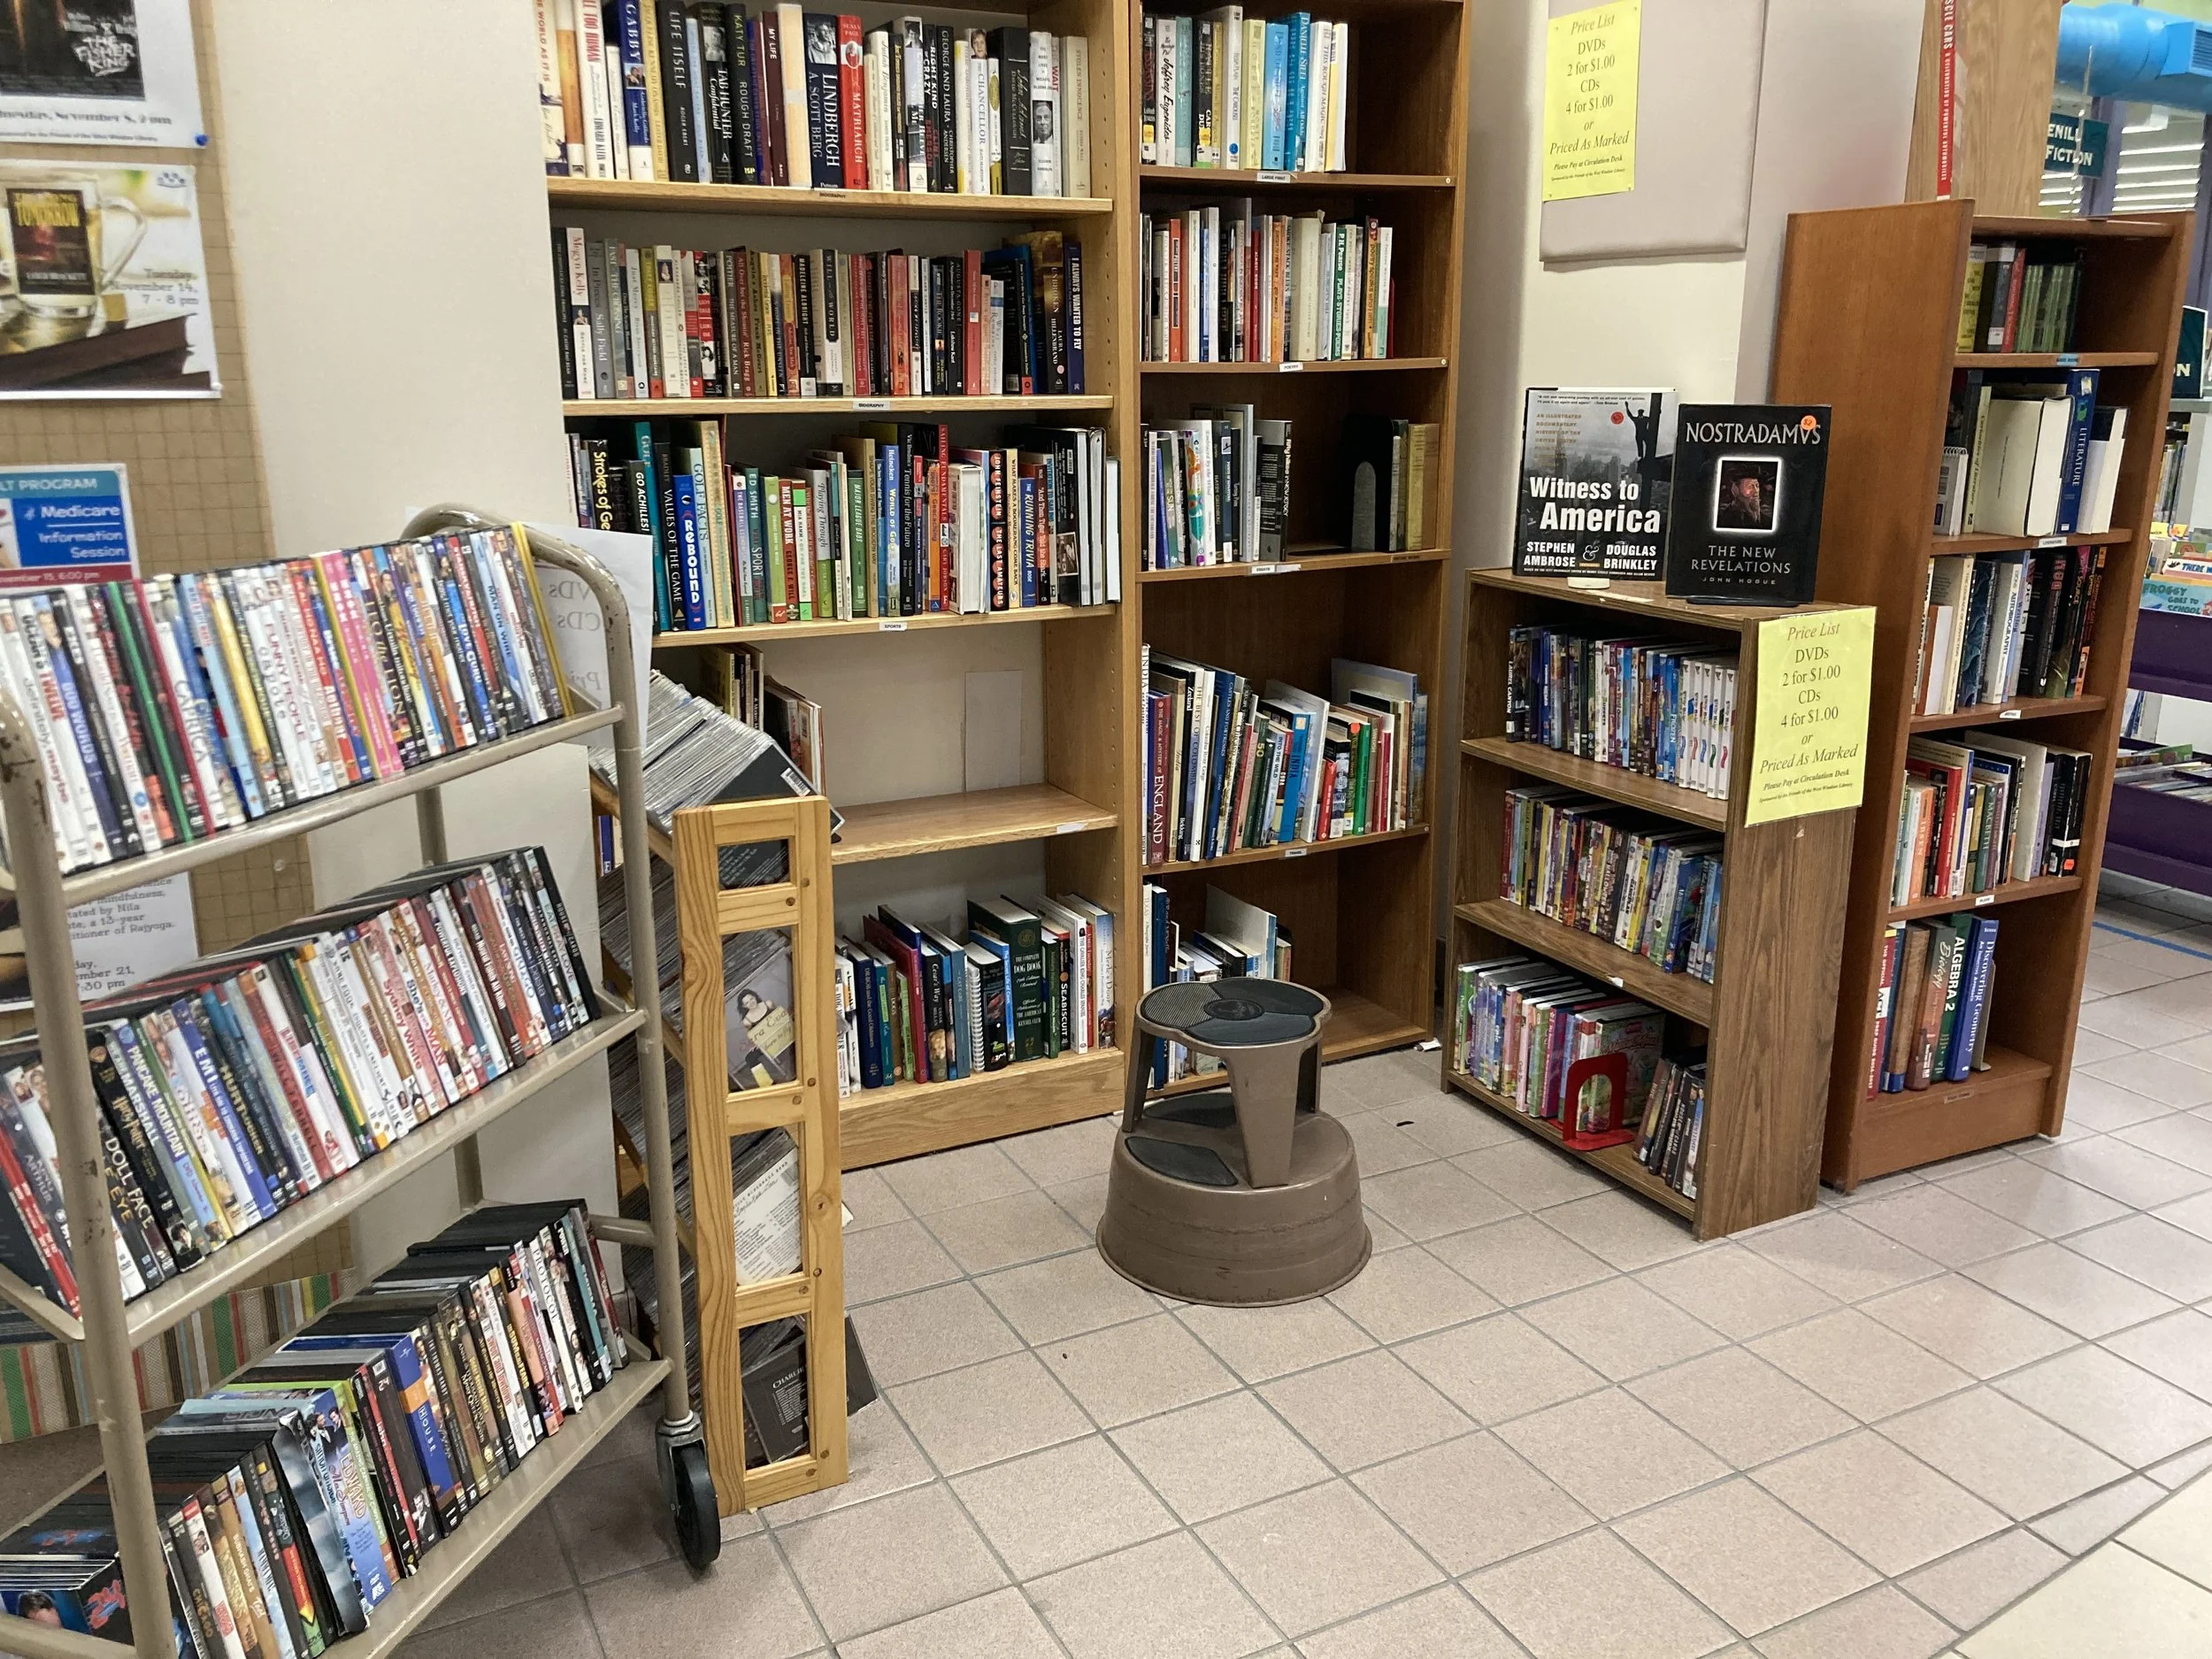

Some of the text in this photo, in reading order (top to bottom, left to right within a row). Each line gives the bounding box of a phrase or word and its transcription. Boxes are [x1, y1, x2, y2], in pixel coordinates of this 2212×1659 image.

[625, 4, 642, 61] GABBY
[768, 28, 776, 41] MY
[1571, 13, 1615, 35] Price List
[669, 11, 686, 88] LIFE ITSELF
[941, 31, 950, 68] GEORGE
[1578, 38, 1606, 55] DVDs
[718, 68, 728, 86] TAB
[1567, 54, 1616, 77] 2 for $1.00
[733, 14, 753, 157] KATY TUR ROUGH DRAFT
[1580, 79, 1600, 93] CDs
[710, 78, 722, 130] Confidential
[978, 74, 987, 144] CHANCELLOR
[1566, 94, 1614, 114] 4 for $1.00
[809, 87, 823, 157] SCOTT BERG
[822, 73, 840, 166] LINDBERGH
[852, 92, 863, 164] MATRIARCH
[1584, 120, 1594, 131] or
[1550, 131, 1630, 155] Priced As Marked
[1554, 159, 1570, 171] Please
[1584, 157, 1609, 167] Circulation
[1610, 154, 1623, 163] Desk
[572, 236, 587, 296] Megyn Kelly
[1071, 262, 1080, 292] ALWAYS
[142, 295, 198, 306] 7 8 pm
[1072, 295, 1081, 325] WANTED
[595, 313, 607, 362] Sally Field
[1073, 326, 1081, 337] TO
[1686, 422, 1821, 445] NOSTRADAMVS
[2072, 427, 2088, 487] LITERATURE
[19, 479, 97, 490] PROGRAM
[594, 451, 609, 510] Strokes of
[694, 463, 703, 500] GOLF
[903, 469, 912, 495] Tennis
[1529, 476, 1639, 501] Witness to
[749, 473, 759, 518] ED SMITH
[995, 480, 1003, 518] FEINSTEIN
[41, 505, 120, 518] Medicare
[781, 486, 794, 545] MEN AT WORK
[1024, 494, 1034, 536] RUNNING
[1540, 502, 1661, 534] America
[39, 531, 123, 543] Information
[664, 488, 683, 603] VALUES OF THE GAME
[71, 546, 125, 558] Session
[752, 547, 764, 577] SPORT
[1025, 538, 1035, 569] TRIVIA
[1524, 555, 1657, 571] AMBROSE BRINKLEY
[1526, 541, 1656, 561] STEPHEN & DOUGLAS
[1708, 545, 1777, 558] THE NEW
[1691, 559, 1791, 574] REVELATIONS
[2182, 563, 2205, 572] THERE
[2142, 583, 2187, 595] FROGGY
[2167, 605, 2200, 614] SCHOOL
[1787, 621, 1840, 641] Price List
[2001, 590, 2017, 656] AUTOBIOGRAPHY
[1794, 647, 1829, 664] DVDs
[1782, 664, 1841, 687] 2 for $1.00
[1798, 688, 1821, 704] CDs
[1781, 706, 1839, 728] 4 for $1.00
[1256, 742, 1265, 758] 50
[1801, 733, 1814, 745] or
[1760, 744, 1859, 774] Priced As Marked
[1763, 780, 1782, 791] Please
[1783, 778, 1793, 788] Pay
[1800, 772, 1833, 783] Circulation
[1834, 769, 1850, 778] Desk
[1153, 775, 1164, 844] ENGLAND
[1982, 802, 1994, 850] MACBETH
[118, 903, 140, 914] Nila
[1014, 961, 1041, 973] DOG BOOK
[1945, 936, 1965, 1012] ALGEBRA 2
[1965, 941, 1994, 1054] Discovering Geometry
[119, 1073, 161, 1148] MARSHALL
[127, 1045, 187, 1158] PANCAKE MOUNTAIN
[104, 1136, 156, 1229] DOLL FACE
[532, 1248, 557, 1324] PROTOCOL
[419, 1406, 436, 1452] HOUSE
